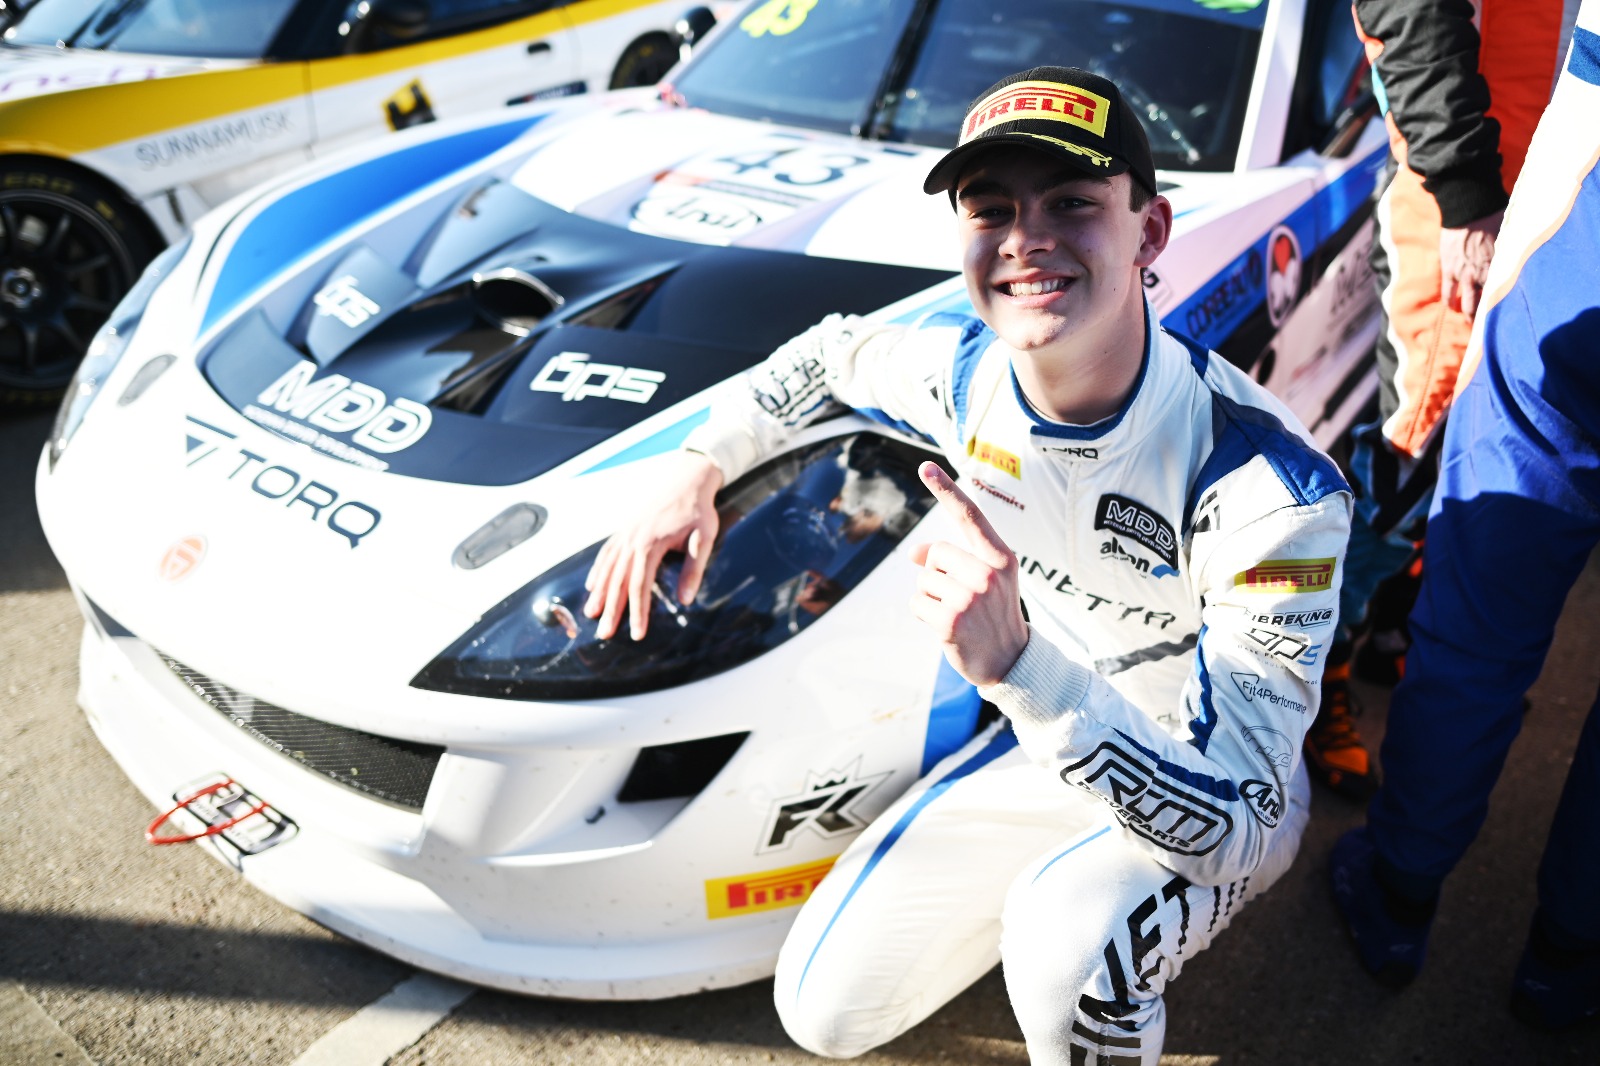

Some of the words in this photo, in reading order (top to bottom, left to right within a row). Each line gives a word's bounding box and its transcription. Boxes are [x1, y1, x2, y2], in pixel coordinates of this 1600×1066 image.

[965, 86, 1098, 138] PIRELLI
[711, 147, 871, 186] 43
[256, 359, 433, 454] MDD
[975, 443, 1018, 475] IRELLI
[1042, 446, 1099, 461] RQ
[228, 448, 382, 550] TORQ
[1105, 500, 1174, 551] MDD
[1018, 551, 1177, 630] INETTA
[1245, 563, 1332, 588] PIRELLI
